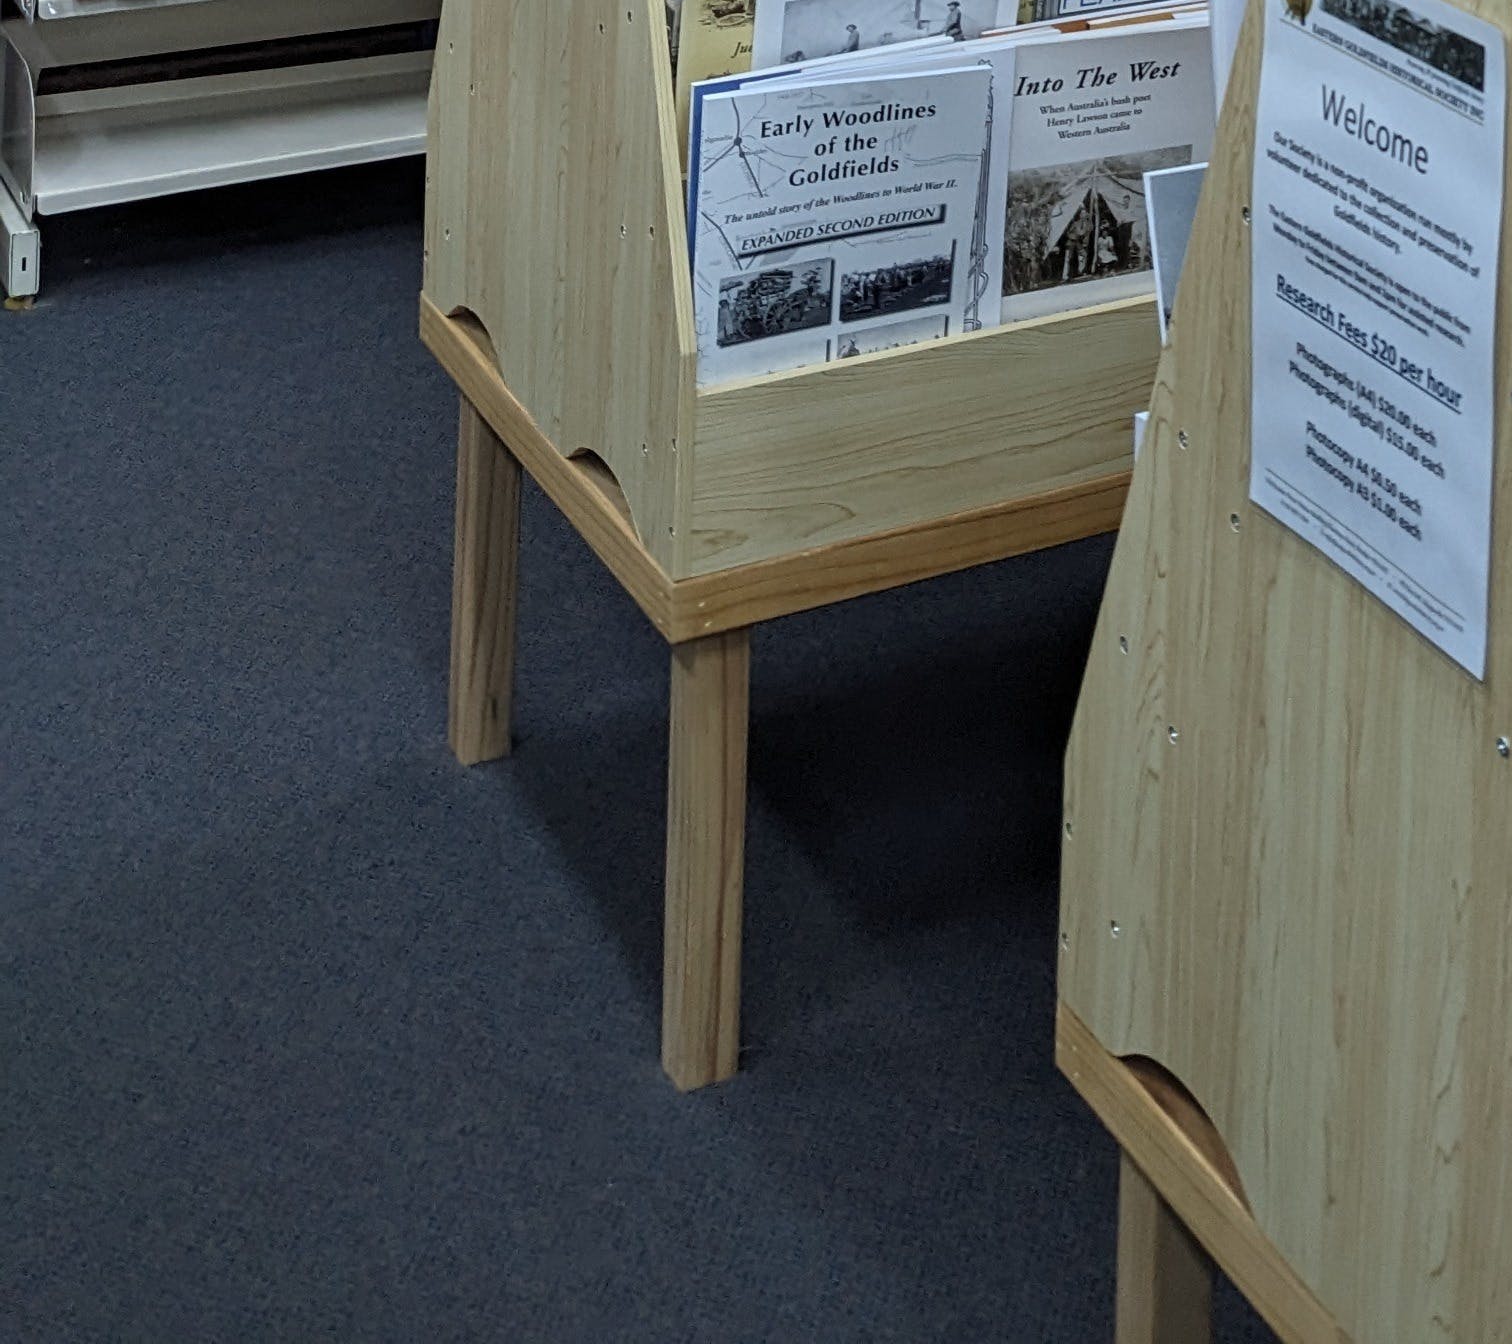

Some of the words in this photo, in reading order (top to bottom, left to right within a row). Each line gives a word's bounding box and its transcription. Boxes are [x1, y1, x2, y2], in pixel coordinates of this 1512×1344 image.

[1013, 74, 1063, 98] Into
[1077, 67, 1117, 88] The
[1129, 61, 1181, 82] West
[760, 112, 814, 139] Early
[823, 102, 937, 130] Woodlines
[1321, 82, 1428, 180] Welcome
[814, 133, 838, 156] of
[845, 133, 877, 153] the
[789, 156, 899, 188] Goldfields
[741, 225, 815, 252] EXPANDED
[817, 216, 875, 238] SECOND
[878, 207, 937, 227] EDITION
[1277, 270, 1334, 330] Research
[1338, 310, 1367, 351] Fees
[1371, 331, 1396, 370] $20
[1400, 355, 1423, 389] per
[1427, 368, 1461, 412] hour
